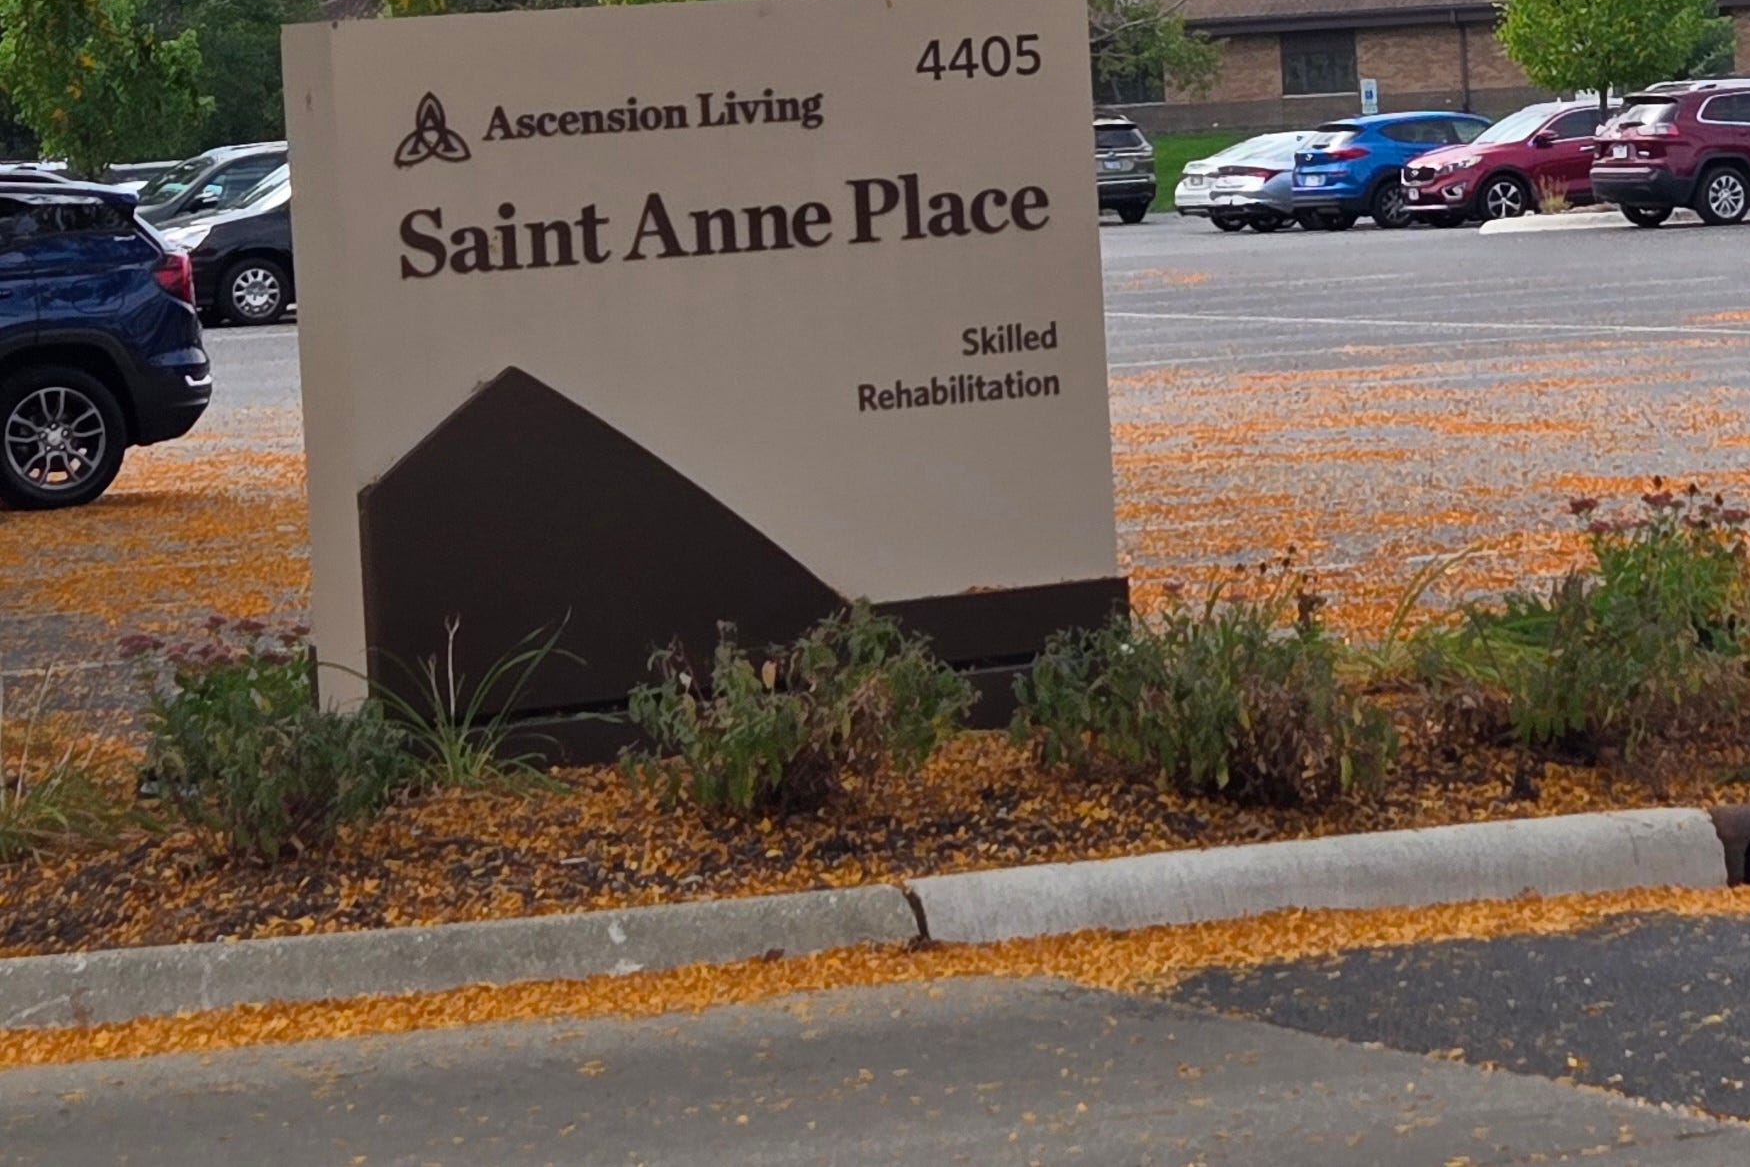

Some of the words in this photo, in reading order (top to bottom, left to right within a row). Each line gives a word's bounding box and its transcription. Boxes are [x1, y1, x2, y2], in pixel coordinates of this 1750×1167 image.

[915, 33, 1041, 81] 4405
[481, 96, 690, 142] Ascension
[695, 87, 824, 130] Living
[399, 202, 612, 281] Saint
[622, 192, 833, 262] Anne
[845, 172, 1050, 245] Place
[962, 320, 1058, 357] Skilled
[857, 372, 1061, 412] Rehabilitation
